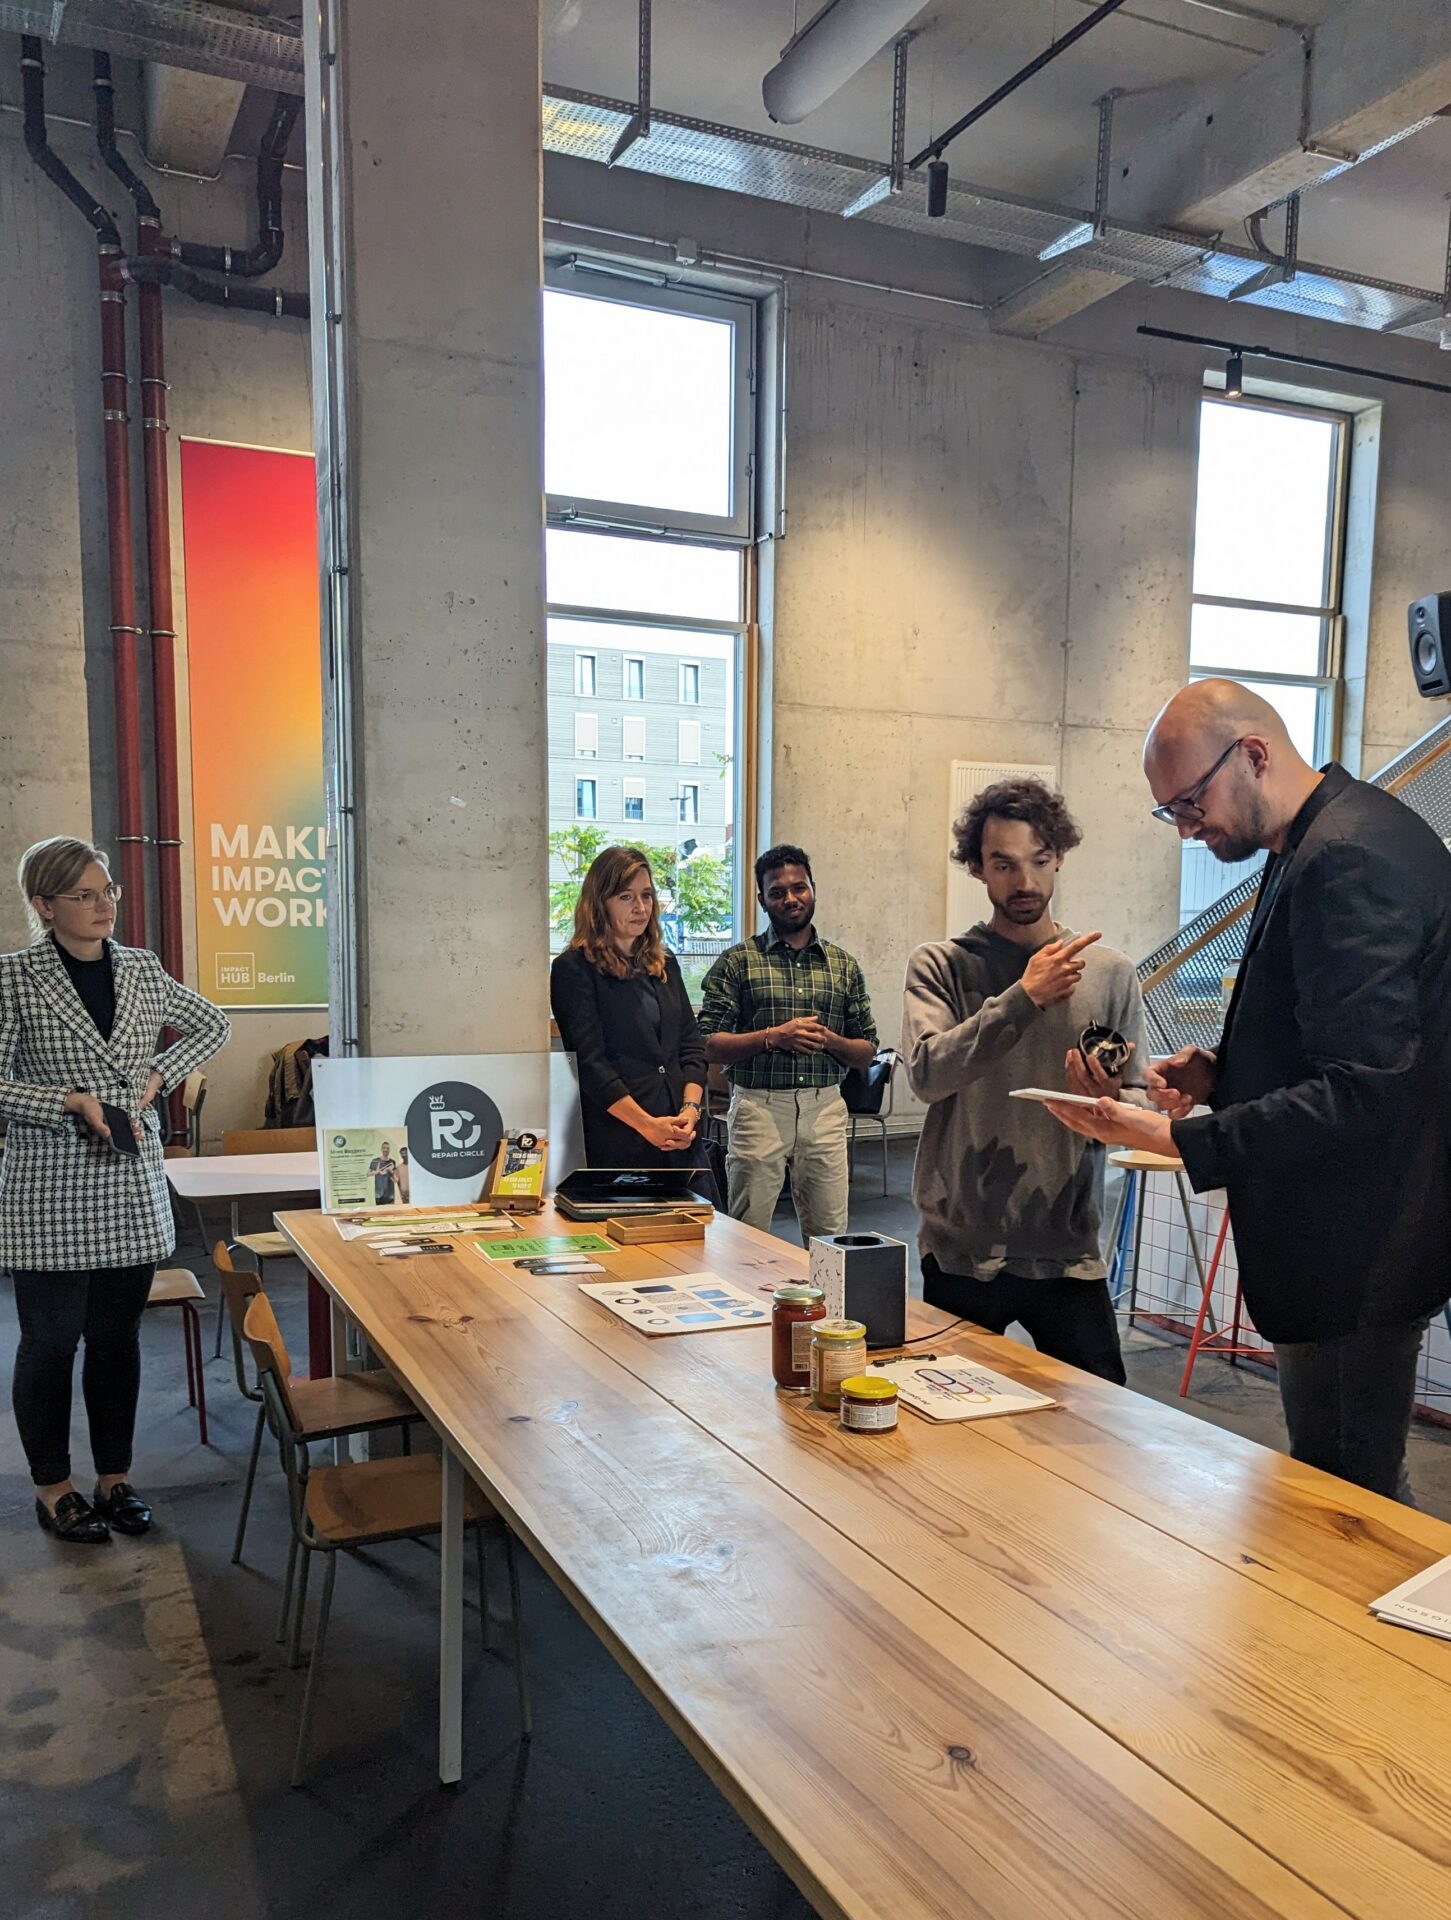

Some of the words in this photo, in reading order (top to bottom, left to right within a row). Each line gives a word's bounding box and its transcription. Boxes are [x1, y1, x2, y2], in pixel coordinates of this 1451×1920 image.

[210, 823, 325, 860] MAK
[211, 865, 326, 893] IMPAC
[220, 972, 250, 984] HUB
[257, 972, 296, 983] Berlin
[431, 1151, 459, 1159] REPAIR
